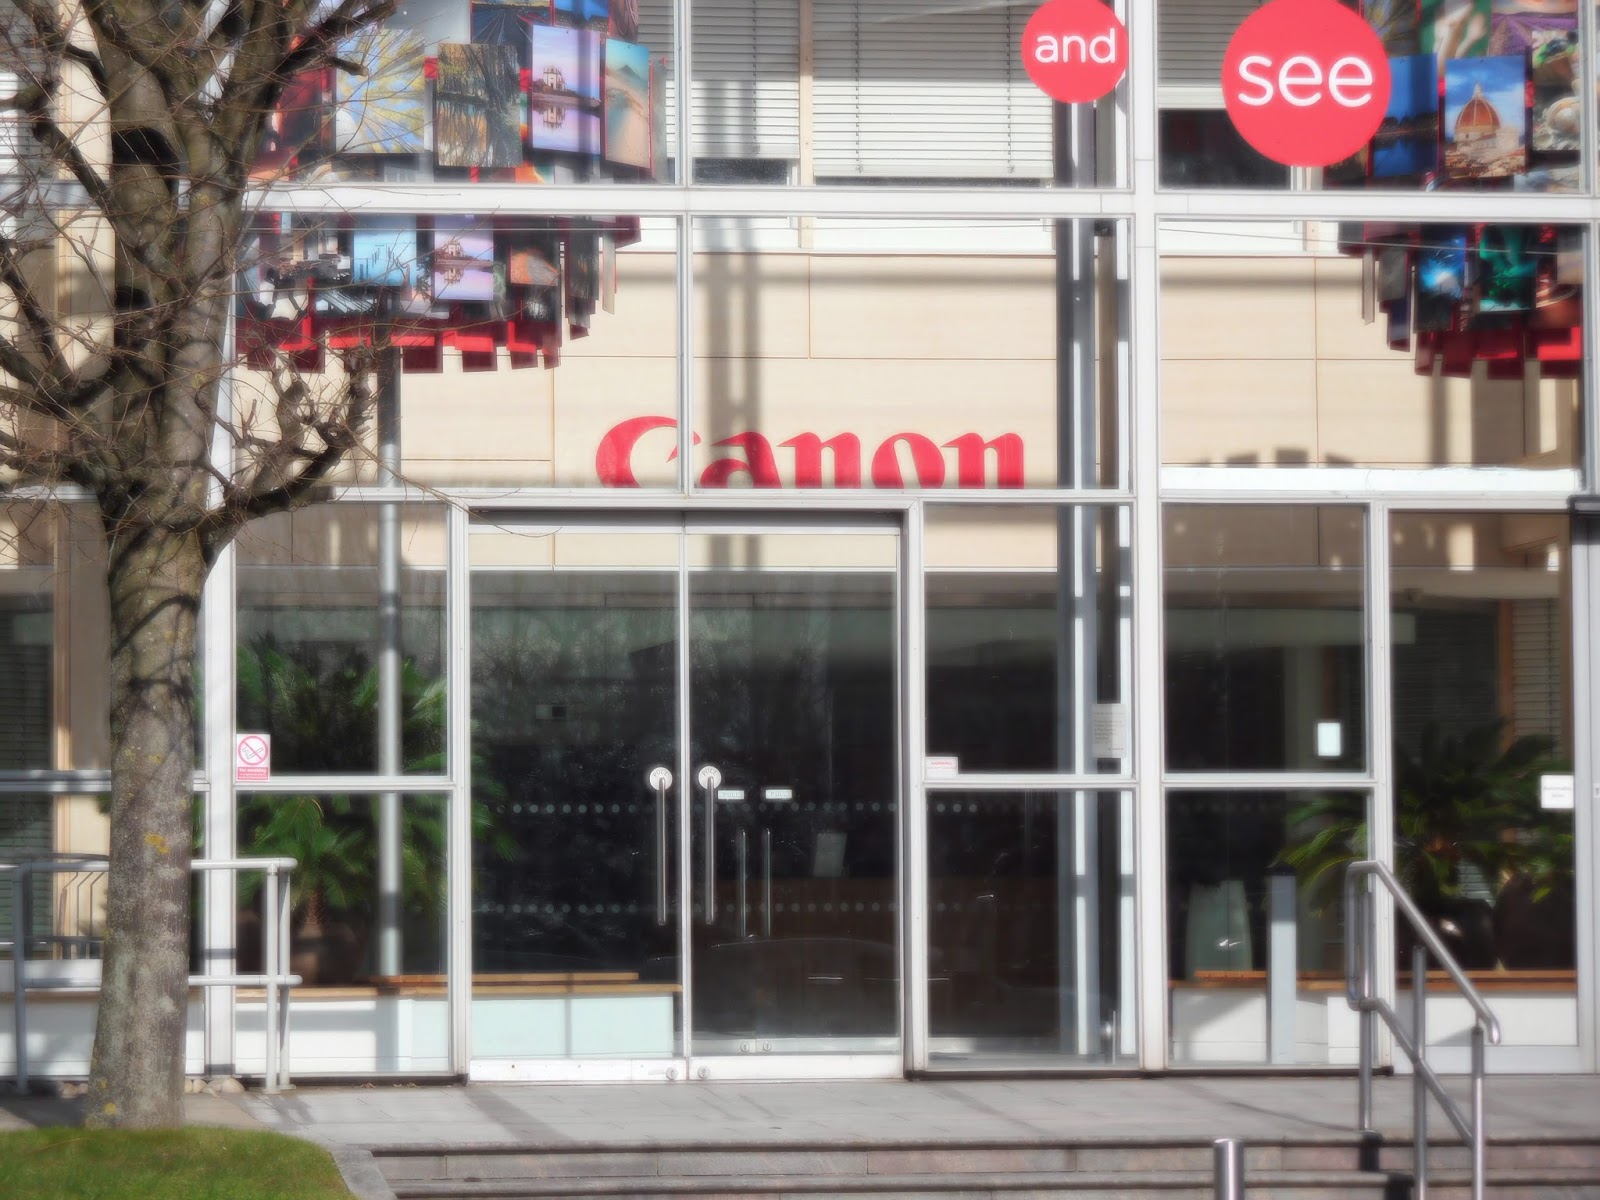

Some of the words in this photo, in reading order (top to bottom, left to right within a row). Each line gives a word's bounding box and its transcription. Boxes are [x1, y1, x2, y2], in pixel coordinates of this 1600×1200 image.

[1035, 28, 1117, 64] and
[1238, 55, 1373, 108] see
[595, 416, 1024, 489] Canon
[652, 769, 669, 778] PULL
[701, 768, 717, 777] PULL
